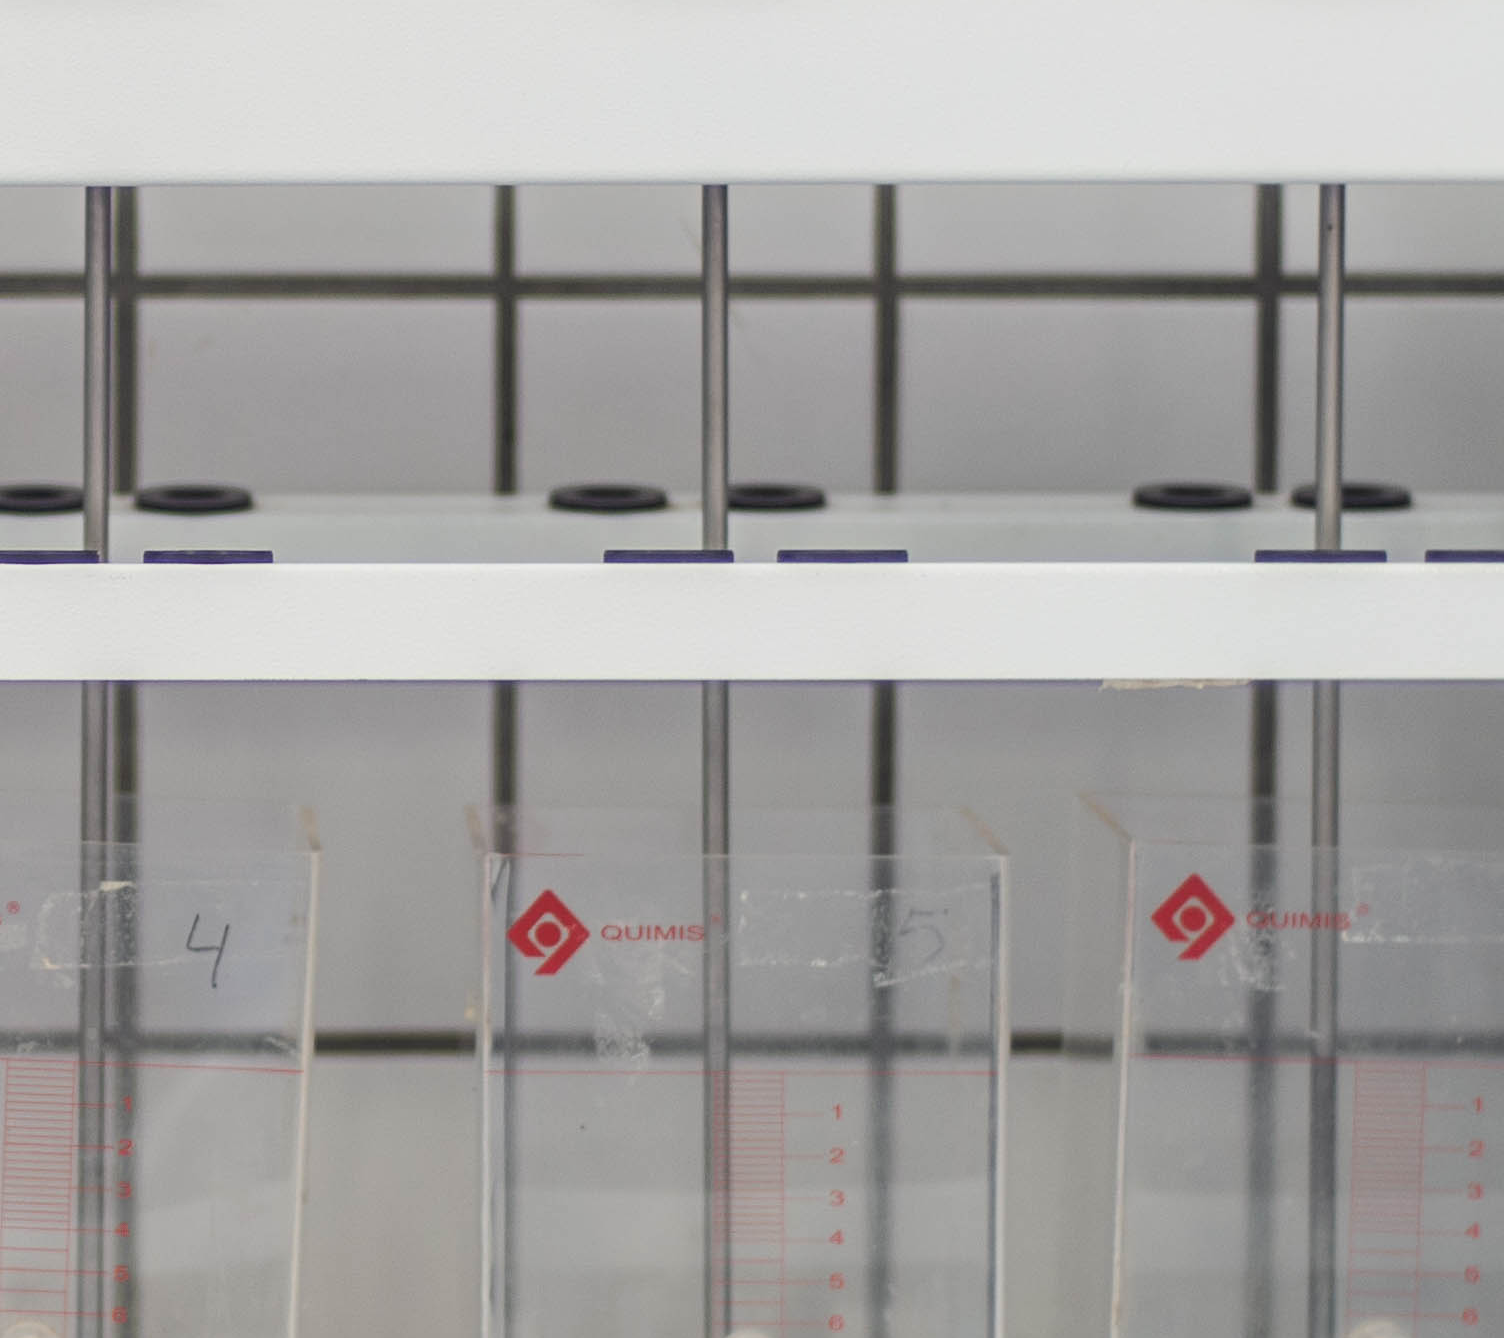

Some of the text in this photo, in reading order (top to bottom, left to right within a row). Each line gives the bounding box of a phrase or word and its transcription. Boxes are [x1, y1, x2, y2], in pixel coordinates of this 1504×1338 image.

[185, 911, 231, 989] 4
[122, 1096, 133, 1113] 1
[831, 1103, 843, 1120] 1
[1473, 1097, 1484, 1114] 1
[117, 1139, 134, 1157] 2
[830, 1147, 846, 1165] 2
[1469, 1140, 1485, 1158] 2
[116, 1181, 132, 1199] 3
[829, 1189, 846, 1206] 3
[1468, 1183, 1485, 1201] 3
[114, 1222, 131, 1238] 4
[828, 1228, 845, 1245] 4
[1464, 1222, 1480, 1239] 4
[114, 1265, 130, 1283] 5
[828, 1272, 845, 1289] 5
[1464, 1265, 1481, 1284] 5
[112, 1306, 128, 1325] 6
[827, 1314, 845, 1333] 6
[1461, 1308, 1479, 1326] 6
